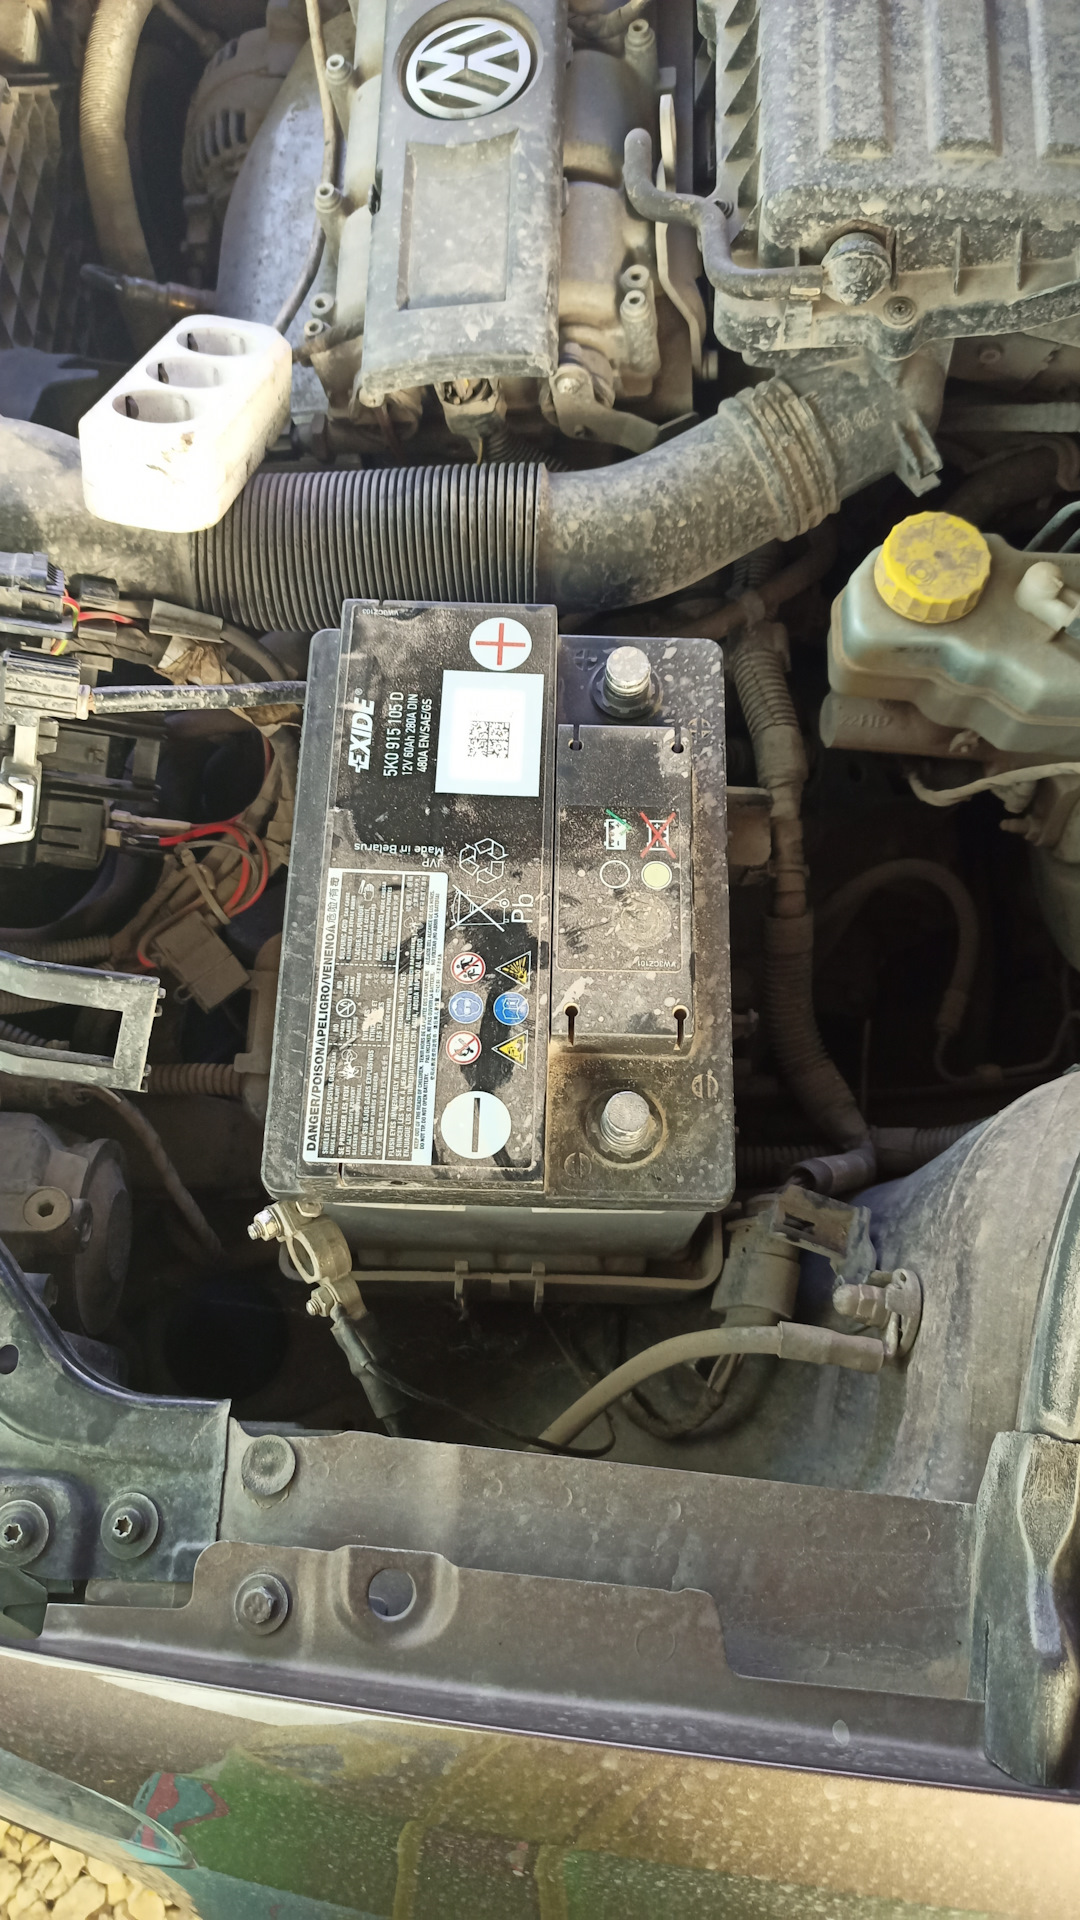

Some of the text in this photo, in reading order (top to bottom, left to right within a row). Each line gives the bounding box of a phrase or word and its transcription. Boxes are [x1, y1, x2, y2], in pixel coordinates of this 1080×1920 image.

[348, 696, 375, 773] EXIDE
[383, 691, 404, 776] 5K0 915 105 D
[402, 693, 418, 775] 12V 60Ah 280A DIN
[417, 698, 432, 773] 480A EN/SAE/GS
[353, 842, 444, 856] Made in Belarus
[422, 857, 444, 868] JVP
[510, 893, 534, 924] Pb
[340, 918, 348, 932] ACID
[338, 933, 347, 959] SULFURIC
[306, 932, 334, 1150] DANGER/POISON PELIGRO/VENENO
[402, 1126, 410, 1157] ENJUAGUE
[411, 991, 419, 1010] ACUDA
[325, 1082, 334, 1114] EXPLOSIVE
[362, 1105, 370, 1121] OJOS
[323, 1116, 331, 1131] EYES
[337, 1114, 347, 1145] PROTÉGER
[321, 1132, 329, 1154] SHIELD
